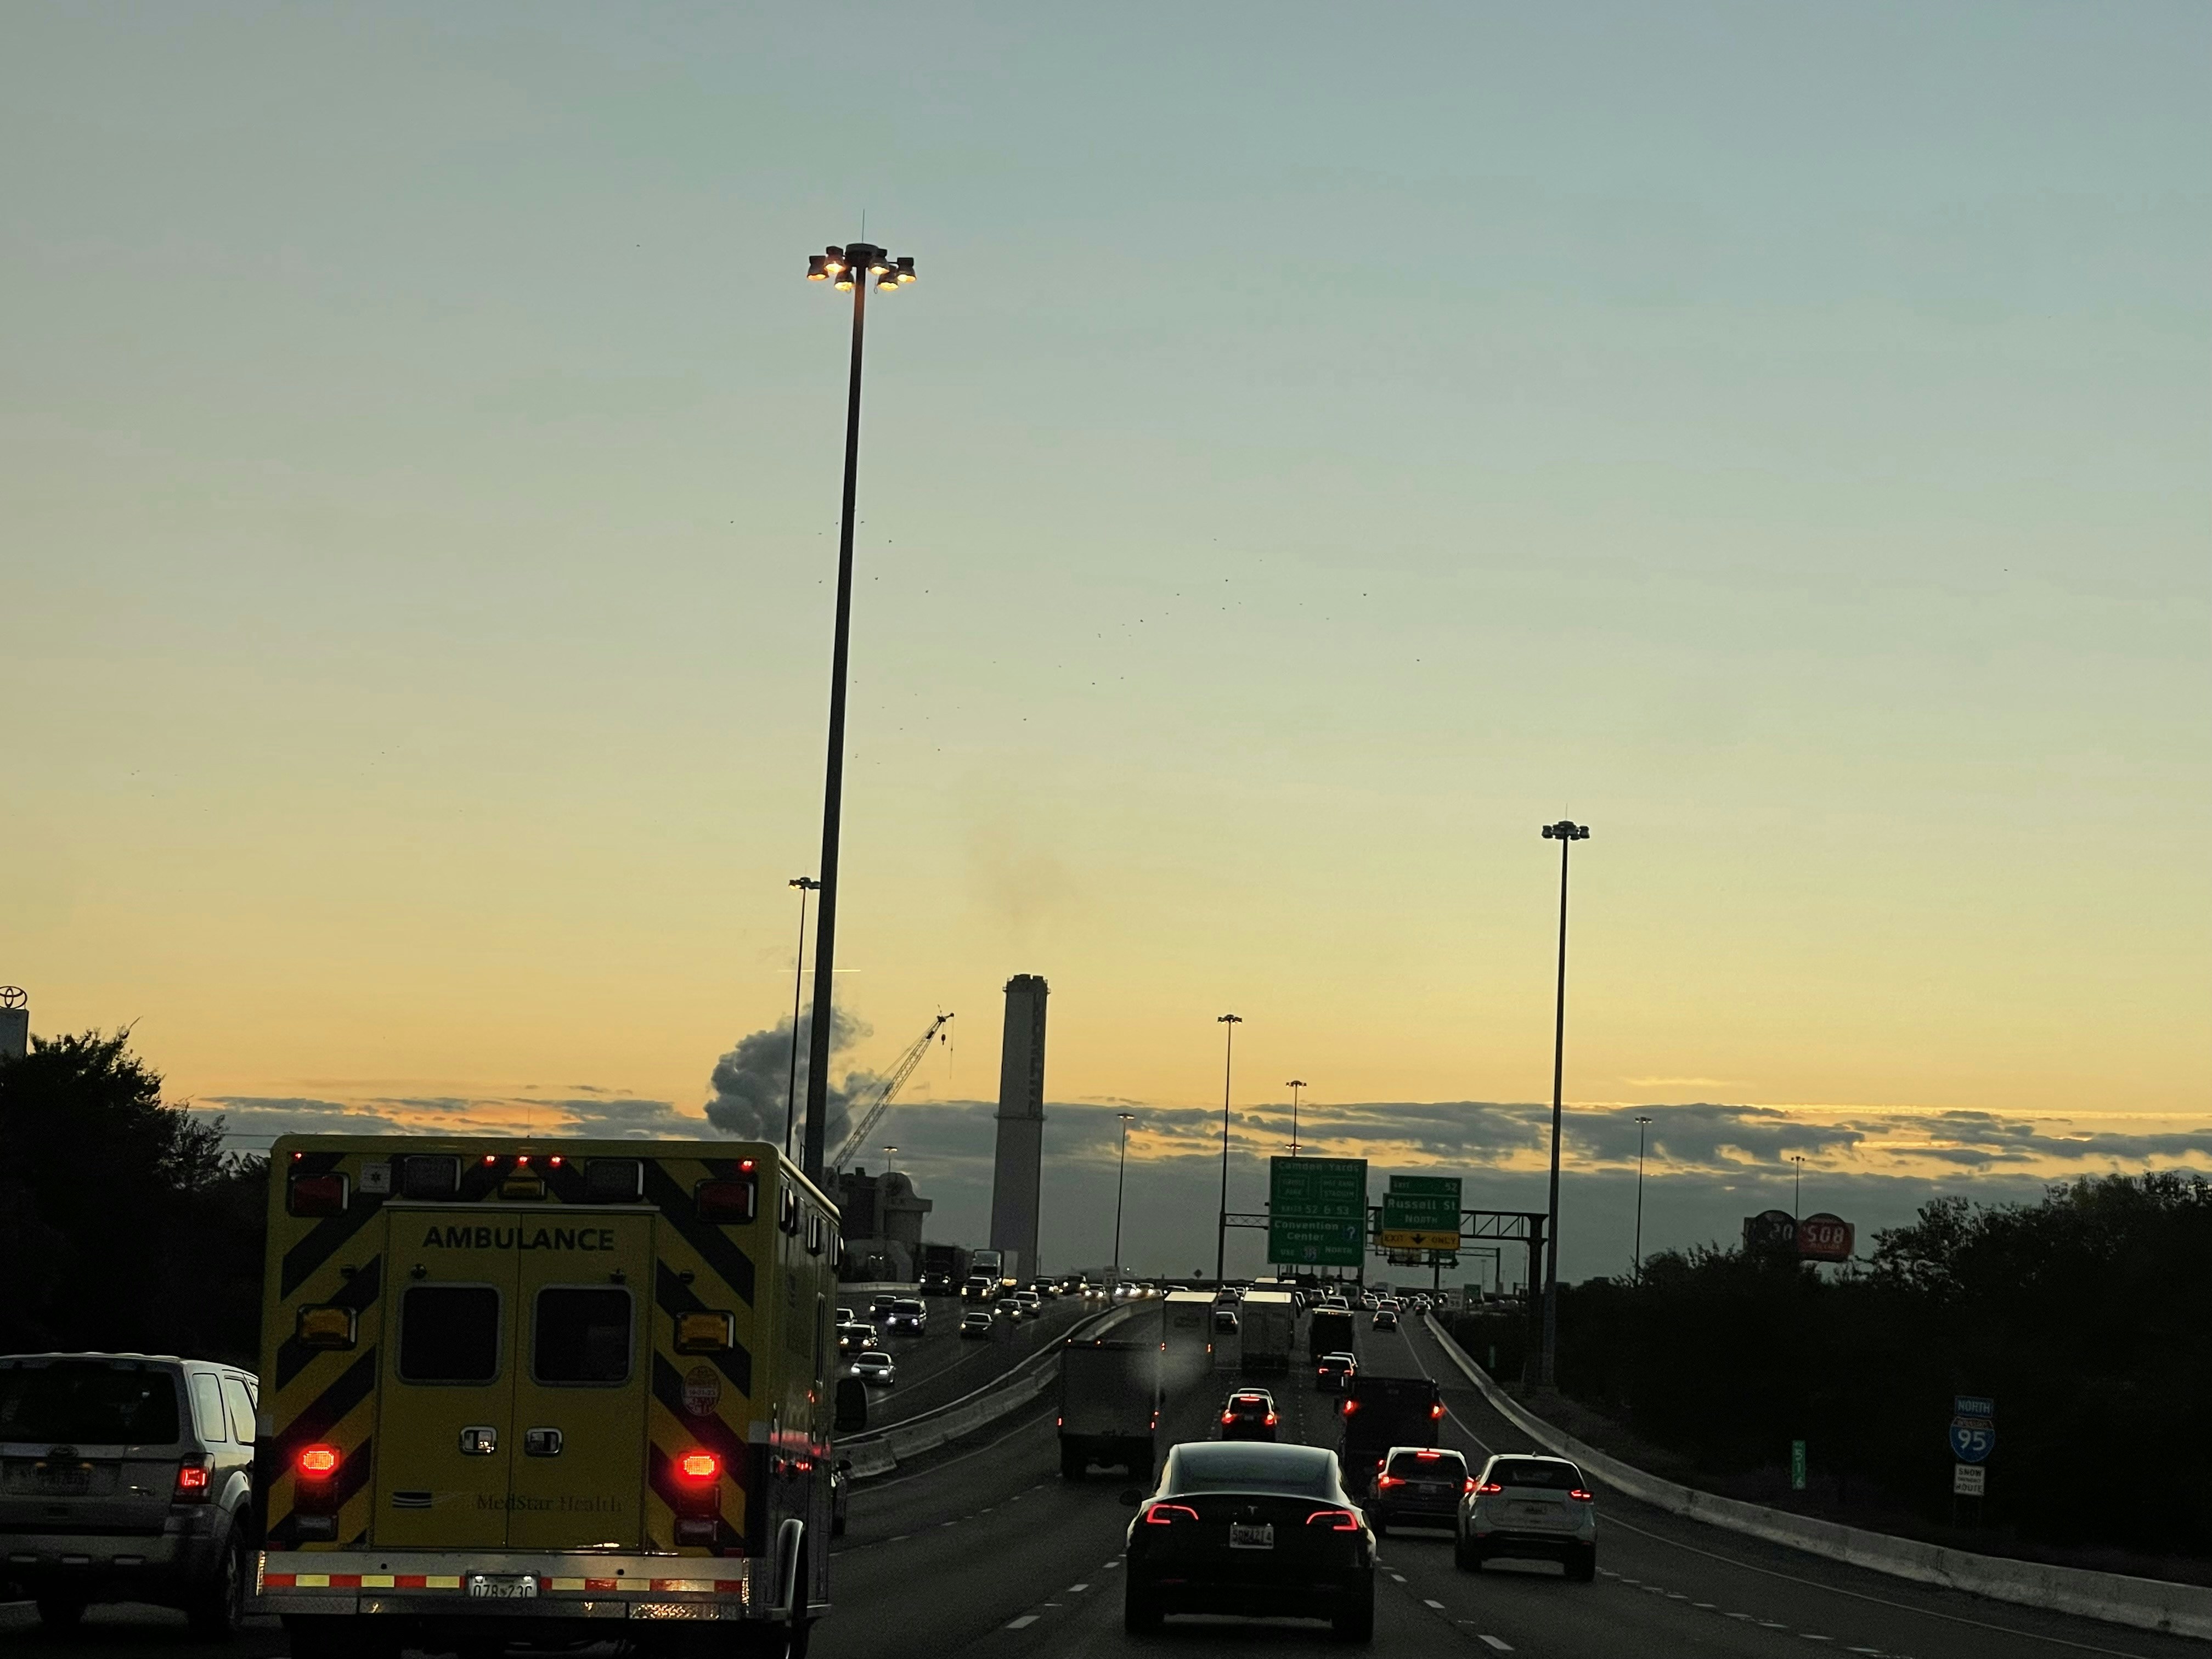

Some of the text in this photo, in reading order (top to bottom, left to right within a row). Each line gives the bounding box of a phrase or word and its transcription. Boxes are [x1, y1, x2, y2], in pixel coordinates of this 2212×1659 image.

[1279, 1162, 1359, 1172] Camden Yards
[1444, 1182, 1458, 1193] 52
[1387, 1199, 1457, 1210] Russell St
[1305, 1205, 1318, 1214] 52
[1336, 1206, 1349, 1215] 53
[1405, 1215, 1437, 1223] NORTH
[1274, 1221, 1339, 1230] Convention
[422, 1227, 614, 1251] AMBULANCE
[1287, 1232, 1324, 1241] Center
[1957, 1400, 1990, 1414] NORTH
[1958, 1429, 1986, 1451] 95
[1959, 1468, 1982, 1476] SNOW
[1956, 1484, 1983, 1493] ROUTE
[477, 1493, 622, 1512] MedStar Health
